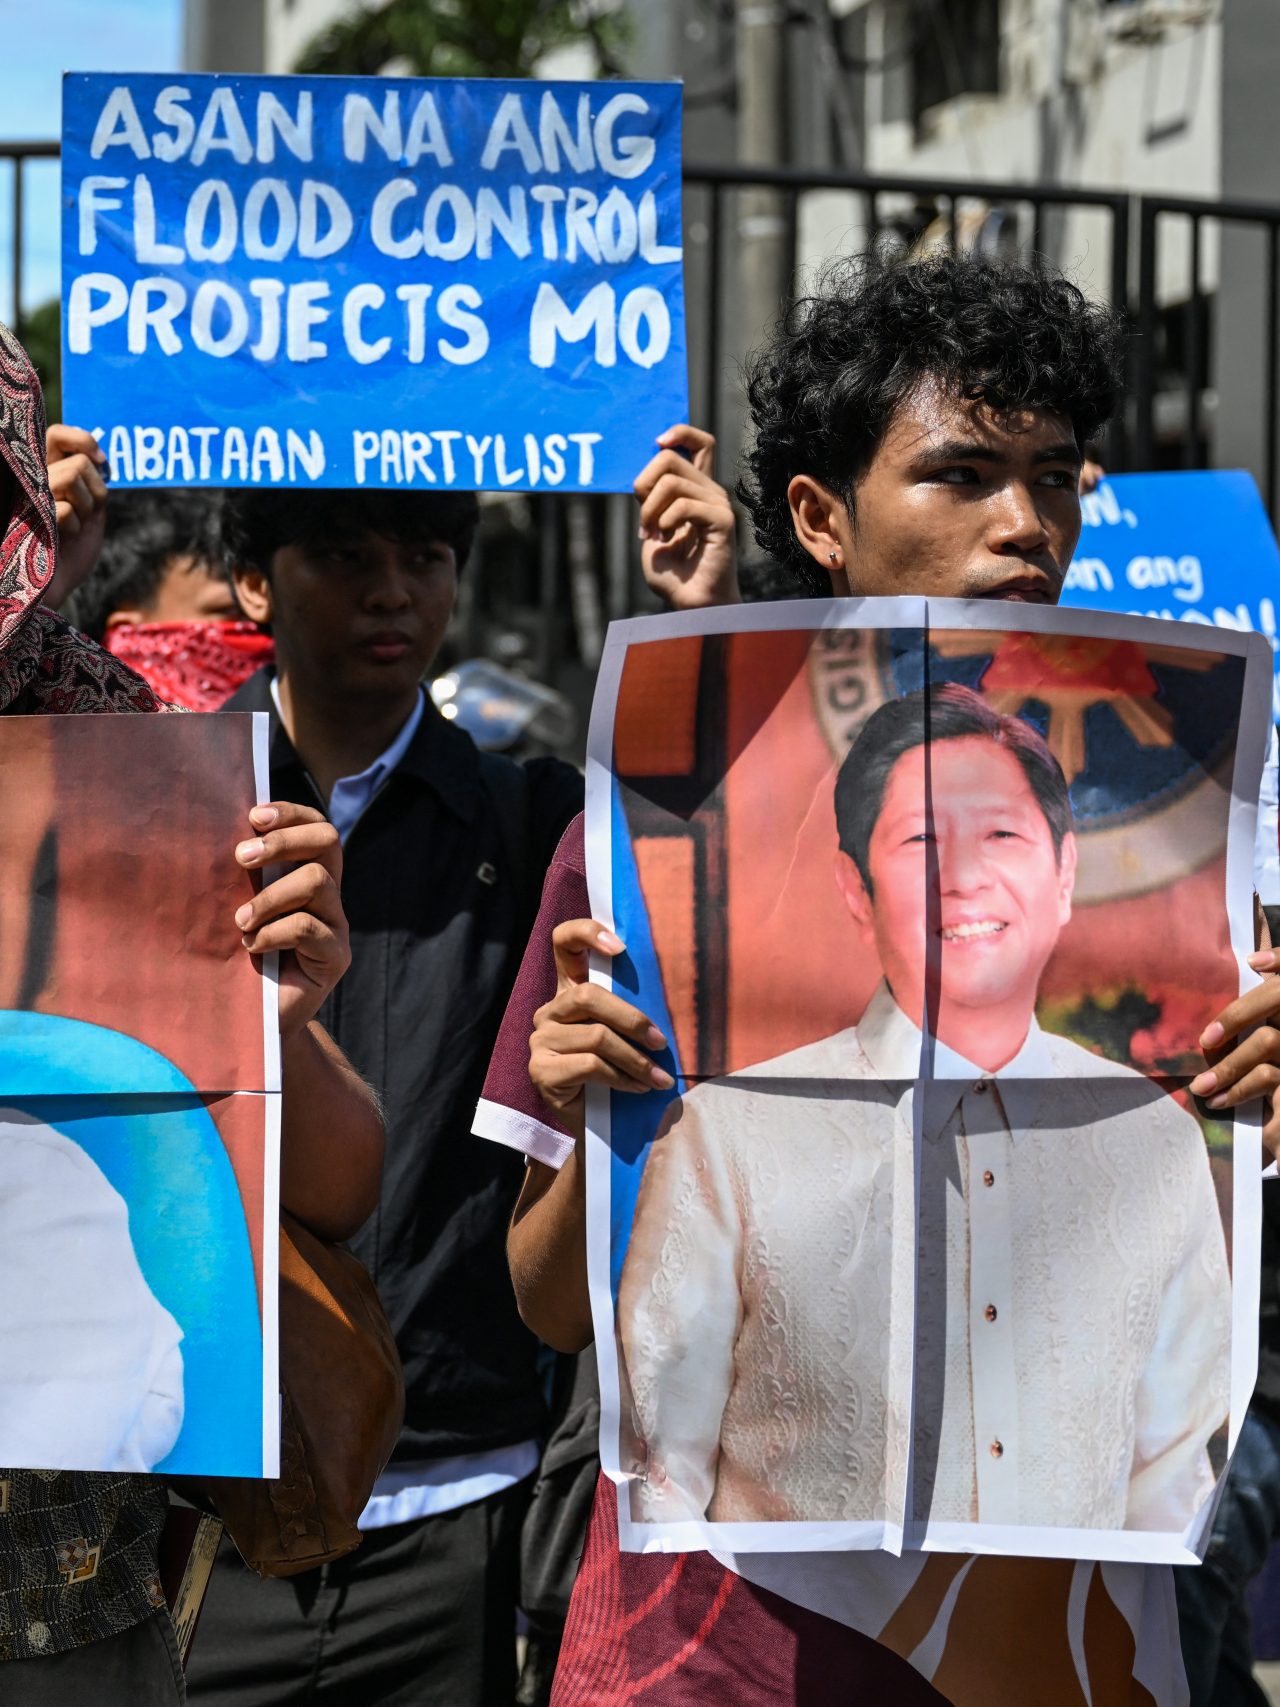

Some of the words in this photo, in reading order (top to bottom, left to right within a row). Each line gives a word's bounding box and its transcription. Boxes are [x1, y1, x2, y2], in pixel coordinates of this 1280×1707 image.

[90, 86, 314, 166] ASAN
[342, 89, 453, 168] NA
[480, 90, 656, 180] ANG
[78, 173, 353, 266] FLOOD
[370, 178, 683, 266] CONTROL
[67, 272, 490, 366] PROJECTS
[528, 281, 672, 369] MO
[352, 429, 603, 487] PARTYLIST
[1126, 555, 1204, 603] ang
